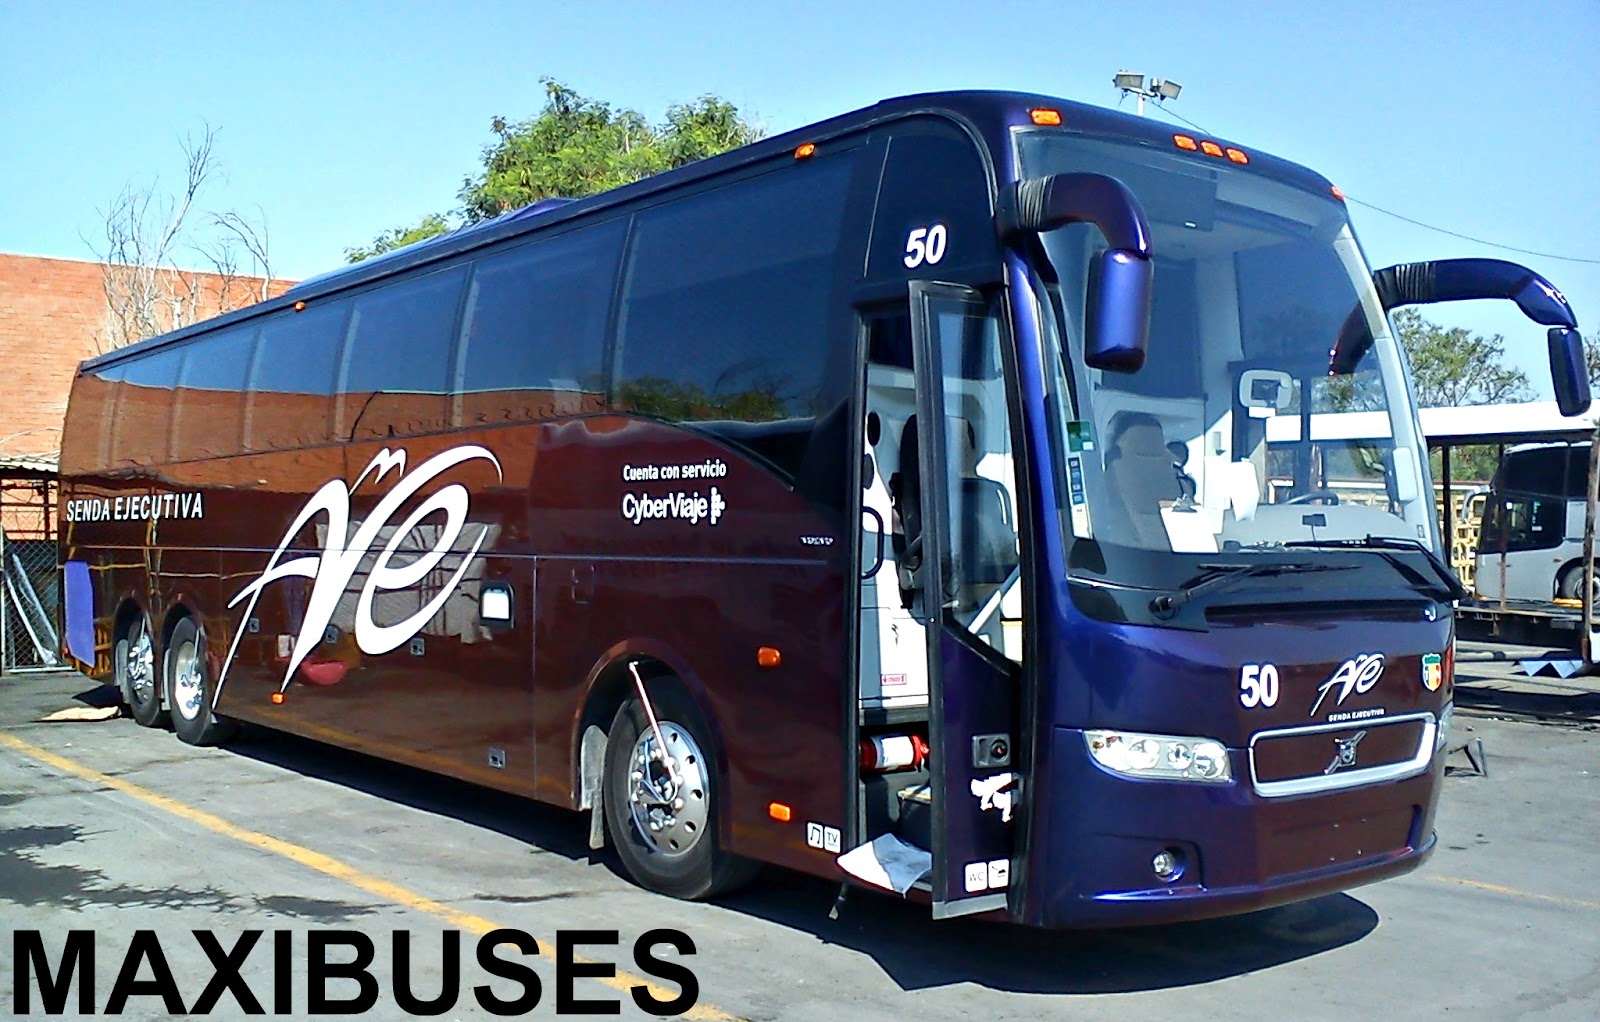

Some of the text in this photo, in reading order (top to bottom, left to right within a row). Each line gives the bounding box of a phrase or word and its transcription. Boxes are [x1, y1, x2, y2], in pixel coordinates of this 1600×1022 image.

[903, 224, 947, 268] 50
[623, 459, 727, 481] Cuenta con servicio
[66, 492, 203, 522] SENDA EJECUTIVA
[622, 492, 708, 524] CyberViaje
[1240, 664, 1279, 708] 50
[1328, 708, 1385, 723] SENDA EJECUTIVA
[826, 831, 838, 843] TV
[968, 871, 984, 882] WC
